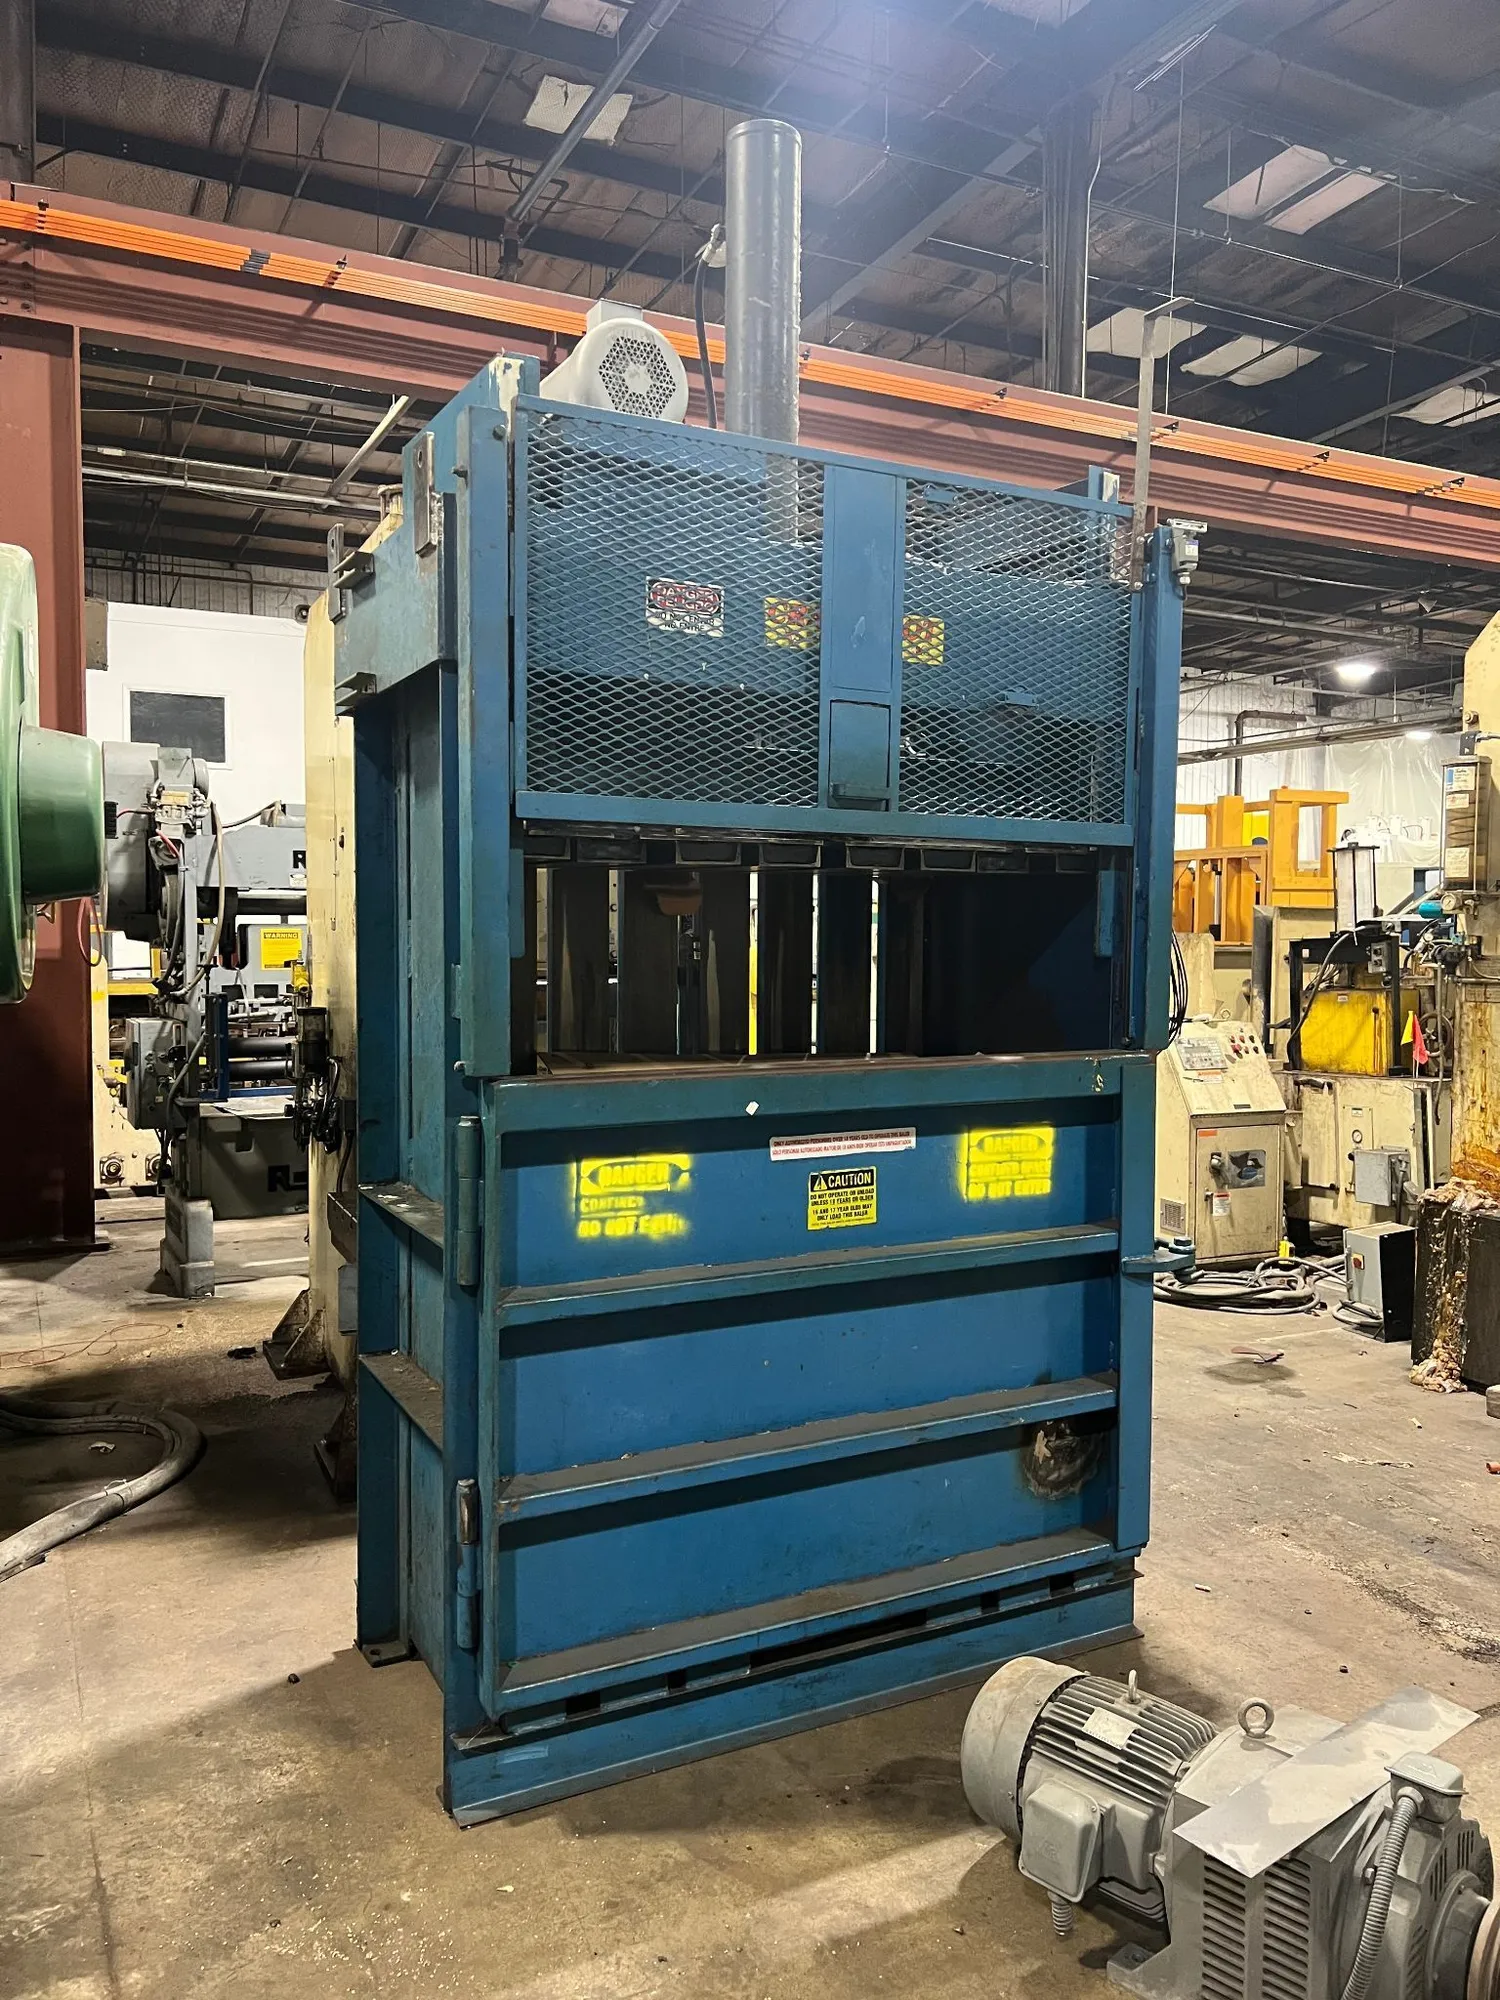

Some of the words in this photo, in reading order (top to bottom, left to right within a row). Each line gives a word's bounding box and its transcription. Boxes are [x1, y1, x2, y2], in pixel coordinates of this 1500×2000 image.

[598, 1162, 670, 1187] DANGER
[828, 1171, 872, 1188] CAUTION
[828, 1190, 849, 1198] OPERATE
[857, 1188, 875, 1196] UNLOAD
[854, 1209, 868, 1217] BALER
